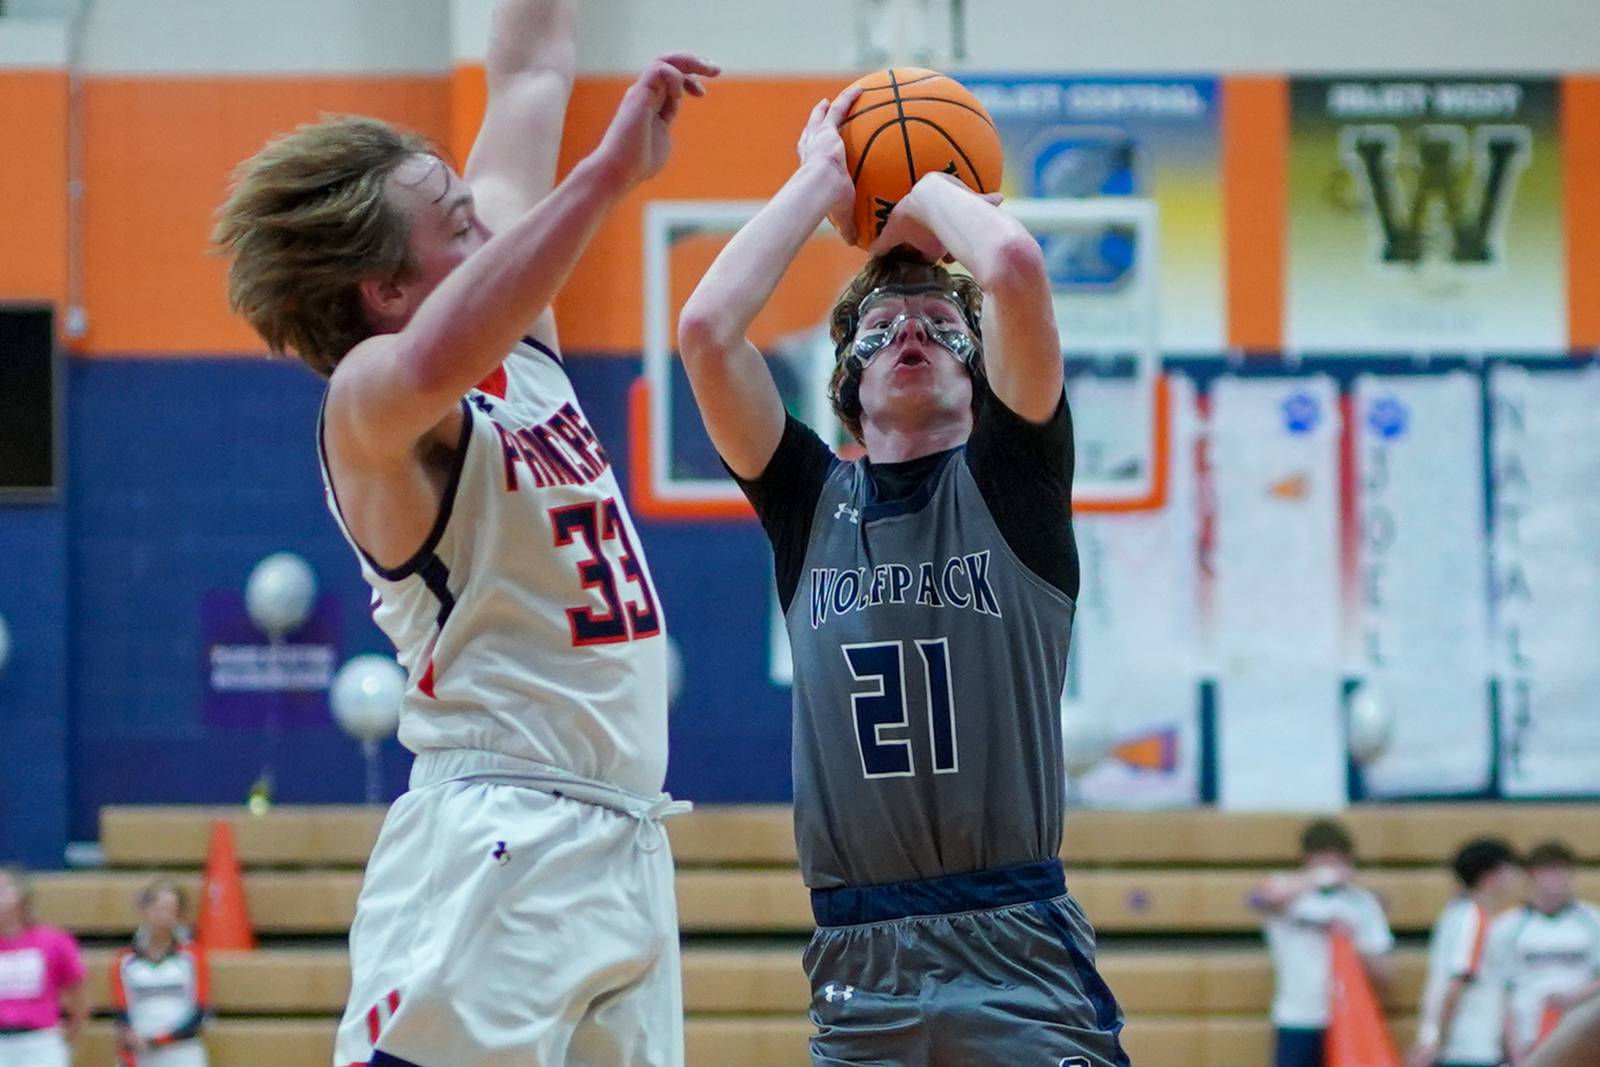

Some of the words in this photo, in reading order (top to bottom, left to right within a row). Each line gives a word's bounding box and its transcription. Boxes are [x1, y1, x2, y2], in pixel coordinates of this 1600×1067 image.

[1340, 125, 1532, 270] W
[547, 497, 661, 647] 33
[811, 550, 1002, 629] WOLFPACK
[840, 637, 959, 779] 21
